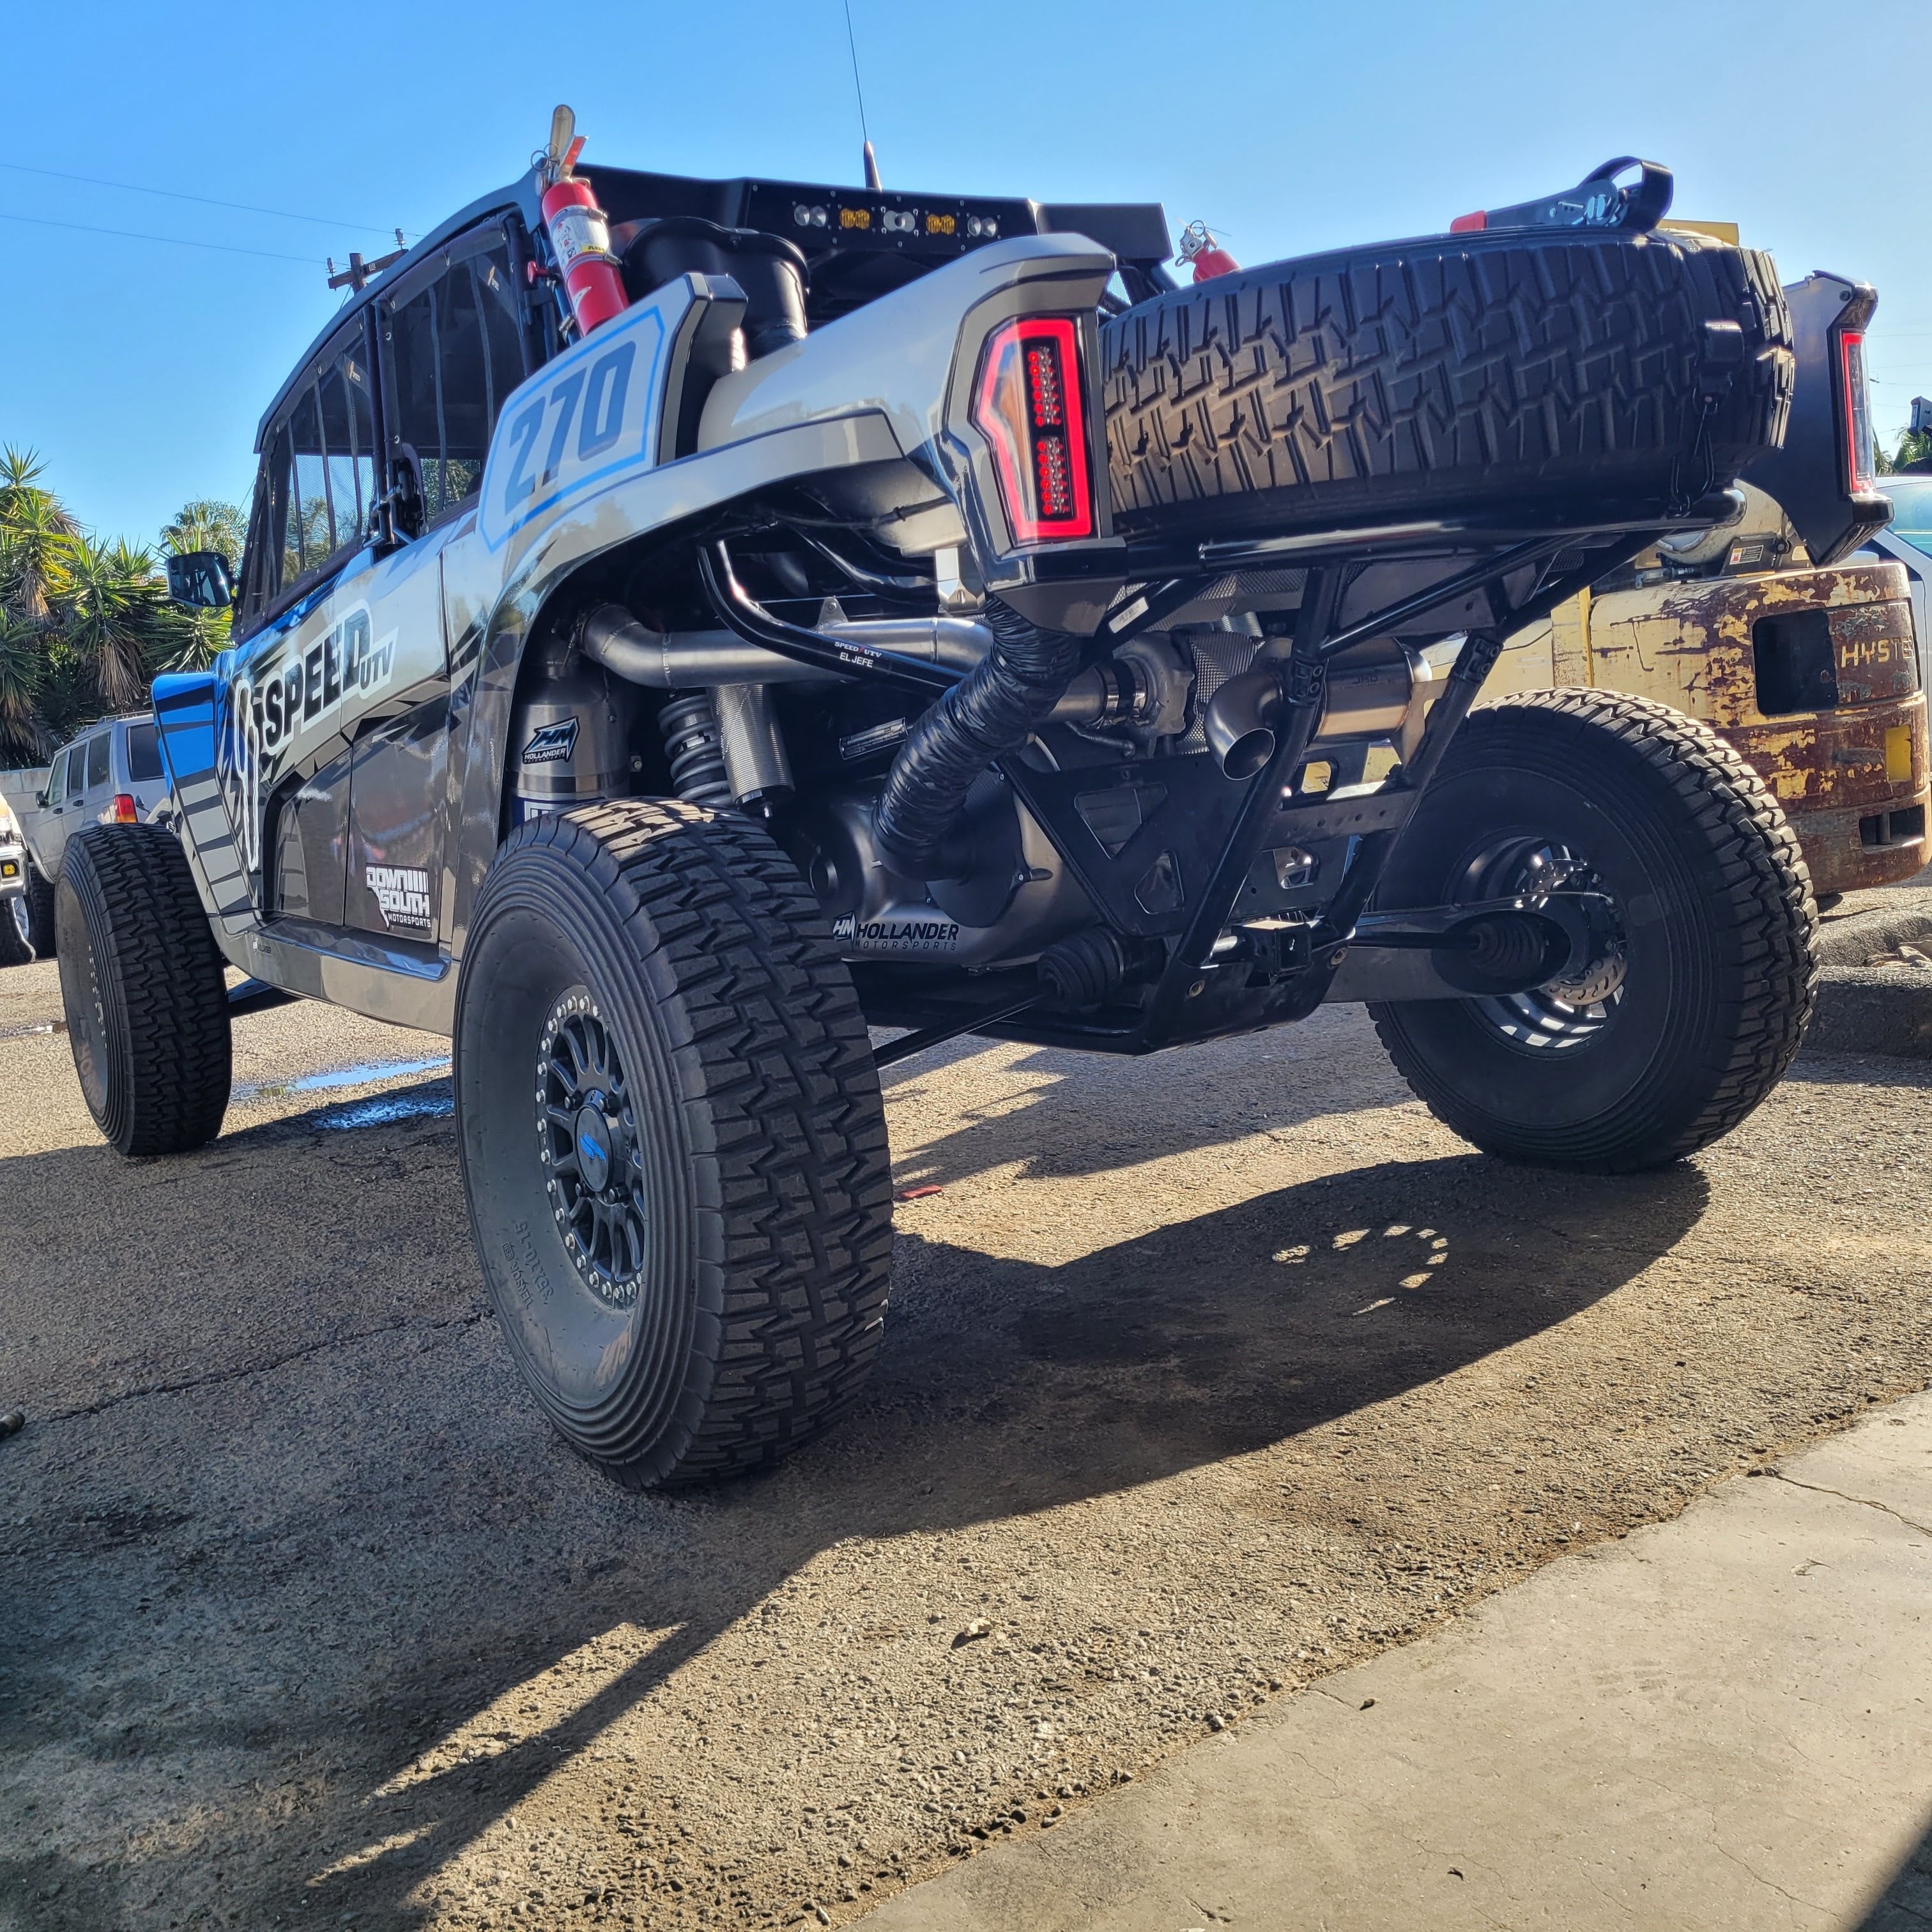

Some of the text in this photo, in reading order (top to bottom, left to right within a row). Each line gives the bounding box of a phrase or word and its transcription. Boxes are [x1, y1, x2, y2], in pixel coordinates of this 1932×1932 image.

[504, 340, 637, 517] 270
[834, 641, 882, 659] SPEED UTV
[839, 652, 874, 668] EL JEFE
[265, 607, 395, 747] SPEED UTV
[524, 747, 567, 760] HOLLANDER
[379, 888, 431, 917] SOUTH
[388, 912, 431, 928] MOTORSPORTS
[857, 923, 959, 942] HOLLANDER
[855, 940, 957, 951] MOTORSPORTS
[510, 1258, 534, 1310] TENSOR
